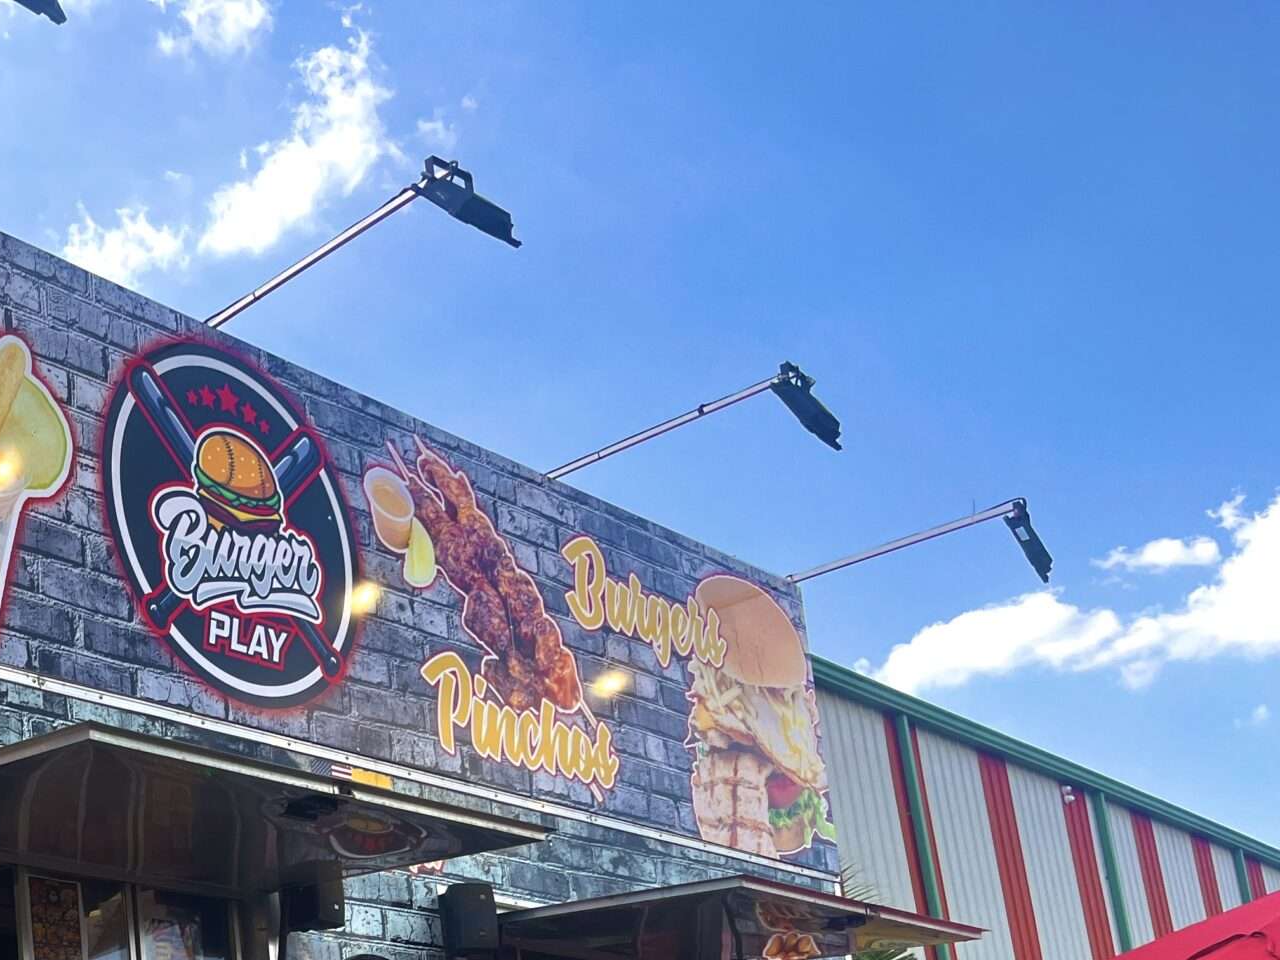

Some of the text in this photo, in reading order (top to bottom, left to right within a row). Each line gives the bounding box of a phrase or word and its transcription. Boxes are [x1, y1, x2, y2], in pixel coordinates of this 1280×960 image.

[152, 492, 322, 612] Burger
[562, 536, 727, 669] Burgers
[209, 612, 287, 664] PLAY
[422, 651, 618, 789] Pinchos
